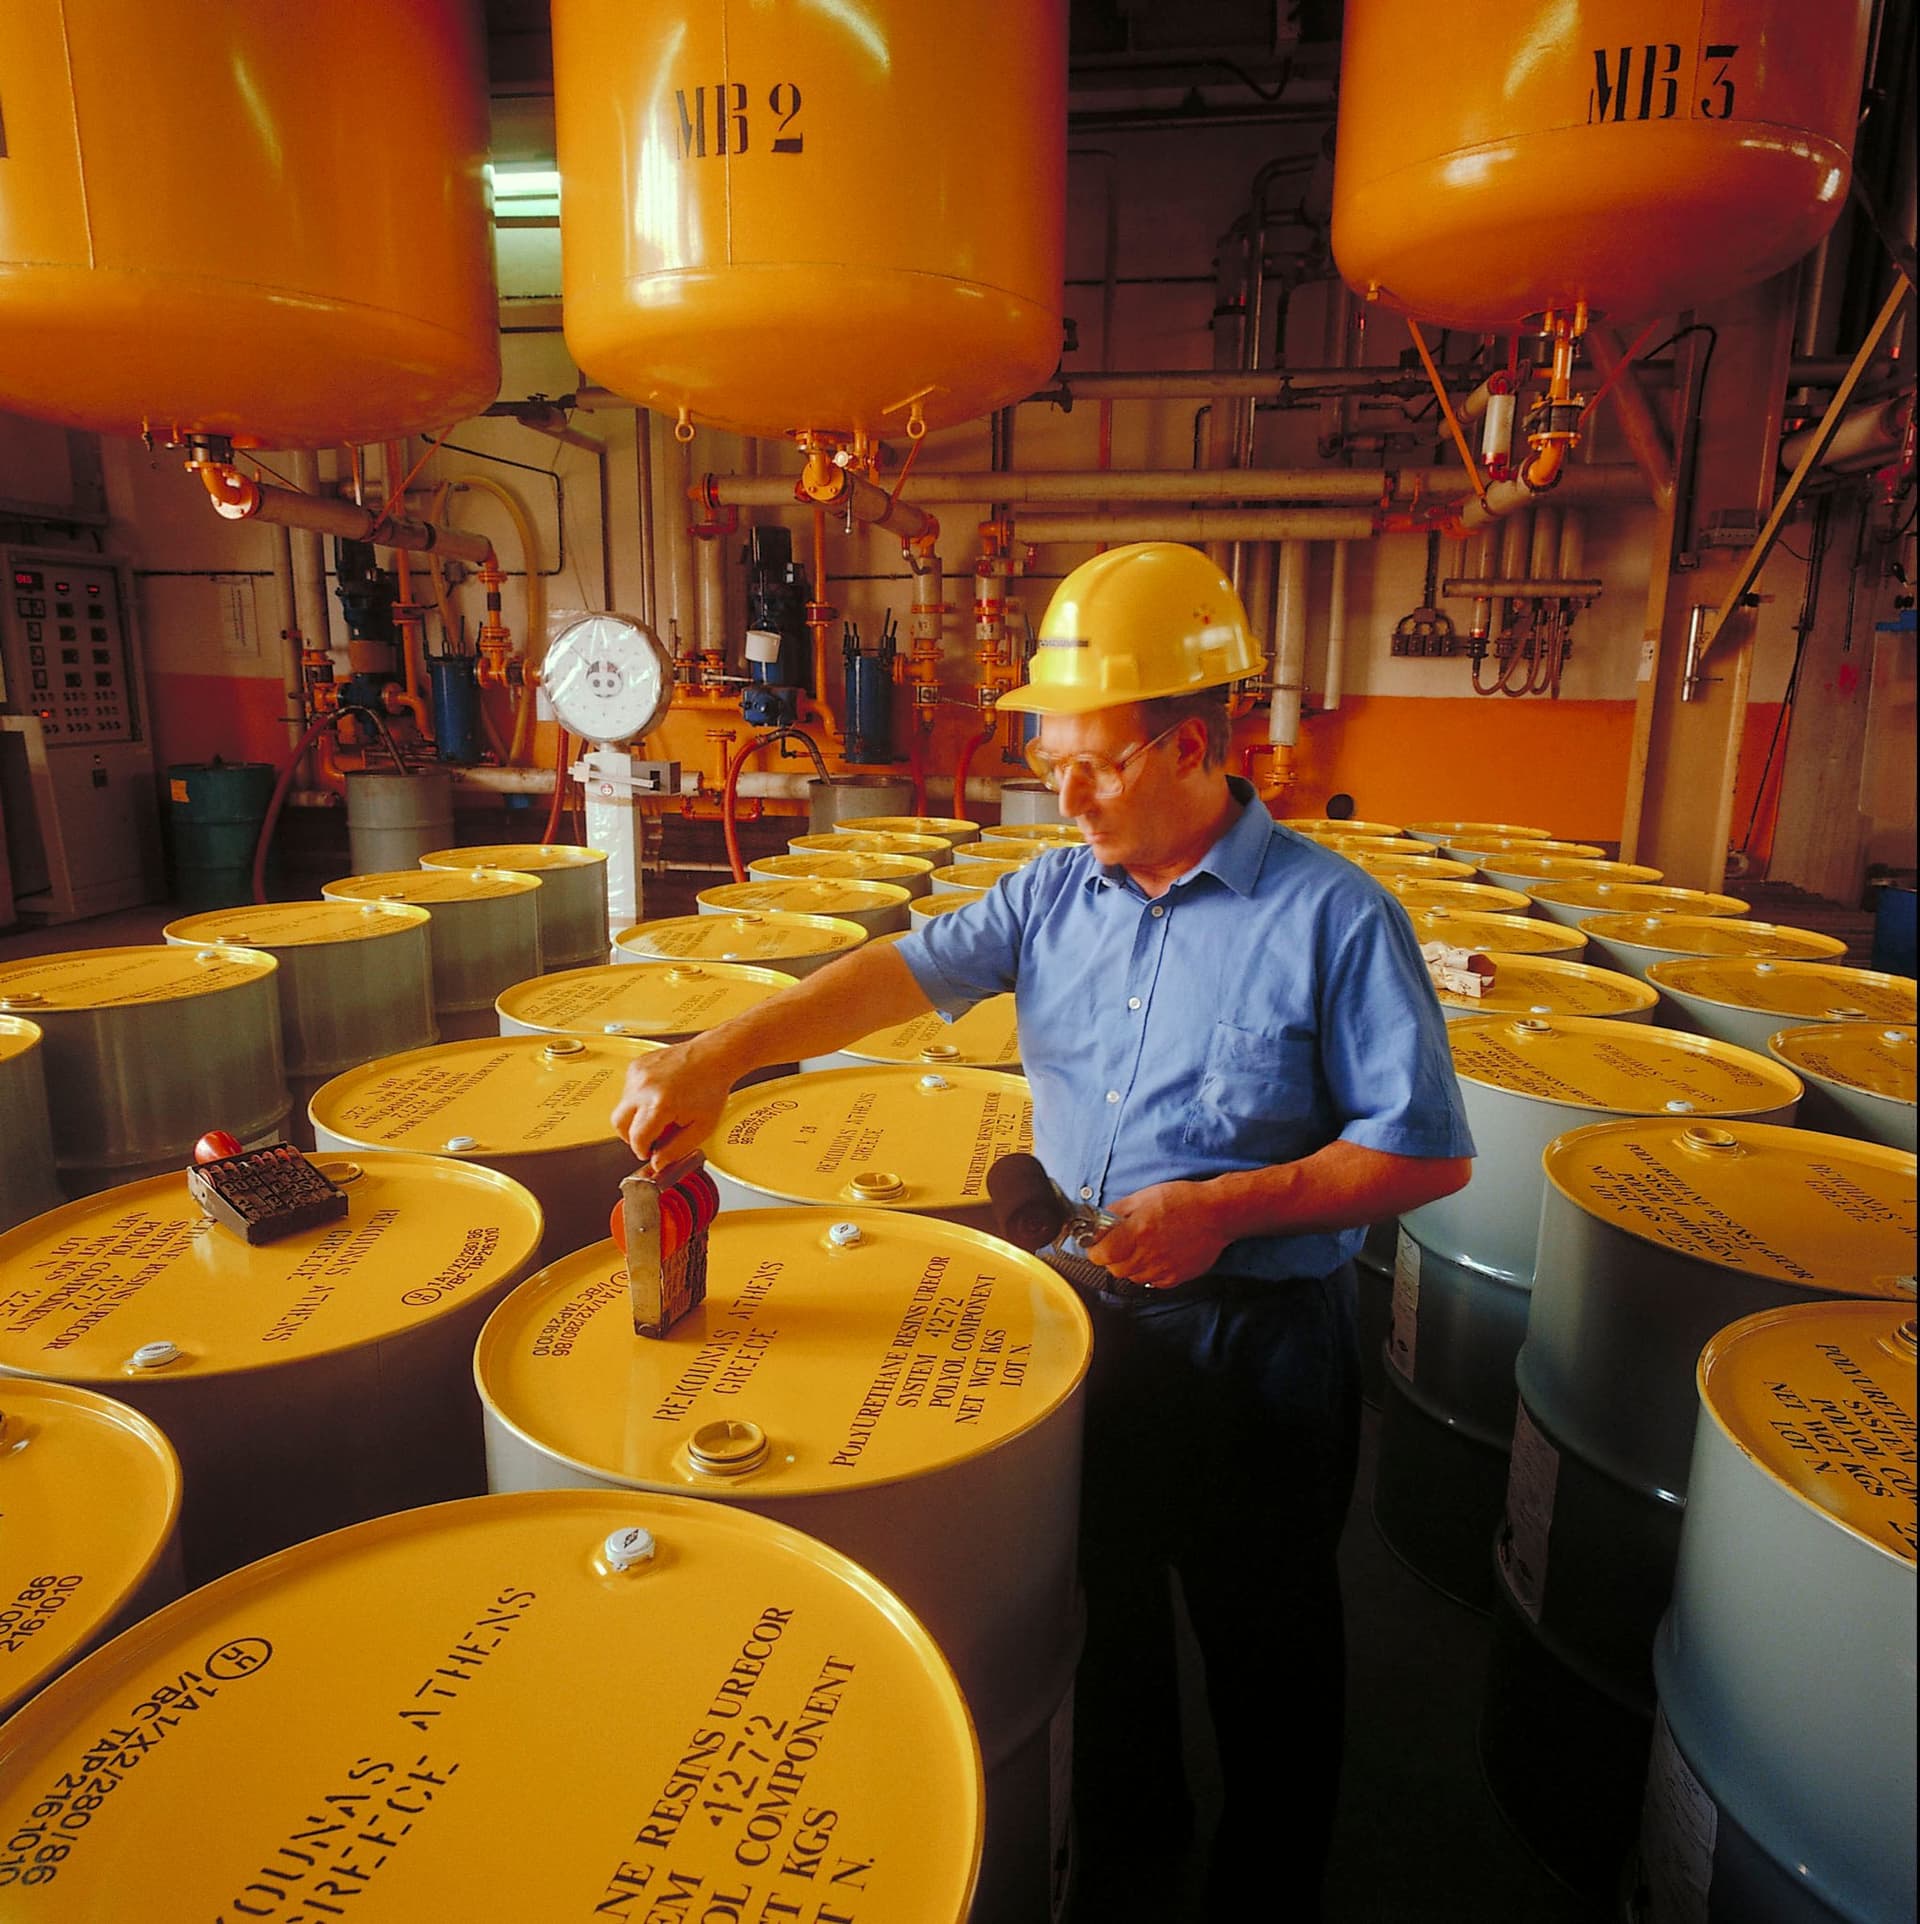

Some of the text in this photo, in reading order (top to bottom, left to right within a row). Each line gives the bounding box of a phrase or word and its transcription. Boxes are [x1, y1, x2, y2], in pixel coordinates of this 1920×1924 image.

[676, 83, 804, 160] MB 2
[1588, 44, 1740, 124] MB 3
[131, 1220, 188, 1259] SYSTEM
[286, 1230, 352, 1280] GREECE
[6, 1262, 111, 1332] COMPONENT
[109, 1263, 168, 1301] RESINS
[262, 1285, 335, 1341] ATHENS
[43, 1303, 120, 1350] URECOR
[652, 1261, 784, 1421] REKOUNAS ATHENS
[713, 1327, 779, 1395] GREECE
[828, 1256, 950, 1467] POLYURETHANE RESINS URECOR
[896, 1297, 964, 1408] SYSTEM 4272
[929, 1274, 996, 1408] POLYOL COMPONENT
[955, 1329, 1007, 1425] NET WGT KGS
[1000, 1359, 1027, 1387] LOT
[1763, 1380, 1897, 1497] NET WGT KGS
[1768, 1419, 1820, 1454] LOT
[1808, 1398, 1886, 1461] POLYOL
[215, 1588, 536, 1924] OUNAS ATHENS
[634, 1729, 726, 1850] RESINS
[707, 1606, 794, 1719] URECOR
[735, 1655, 856, 1867] COMPONENT
[703, 1715, 788, 1827] 4272
[286, 1755, 459, 1924] REECE
[780, 1807, 839, 1880] KGS
[830, 1856, 875, 1891] N.
